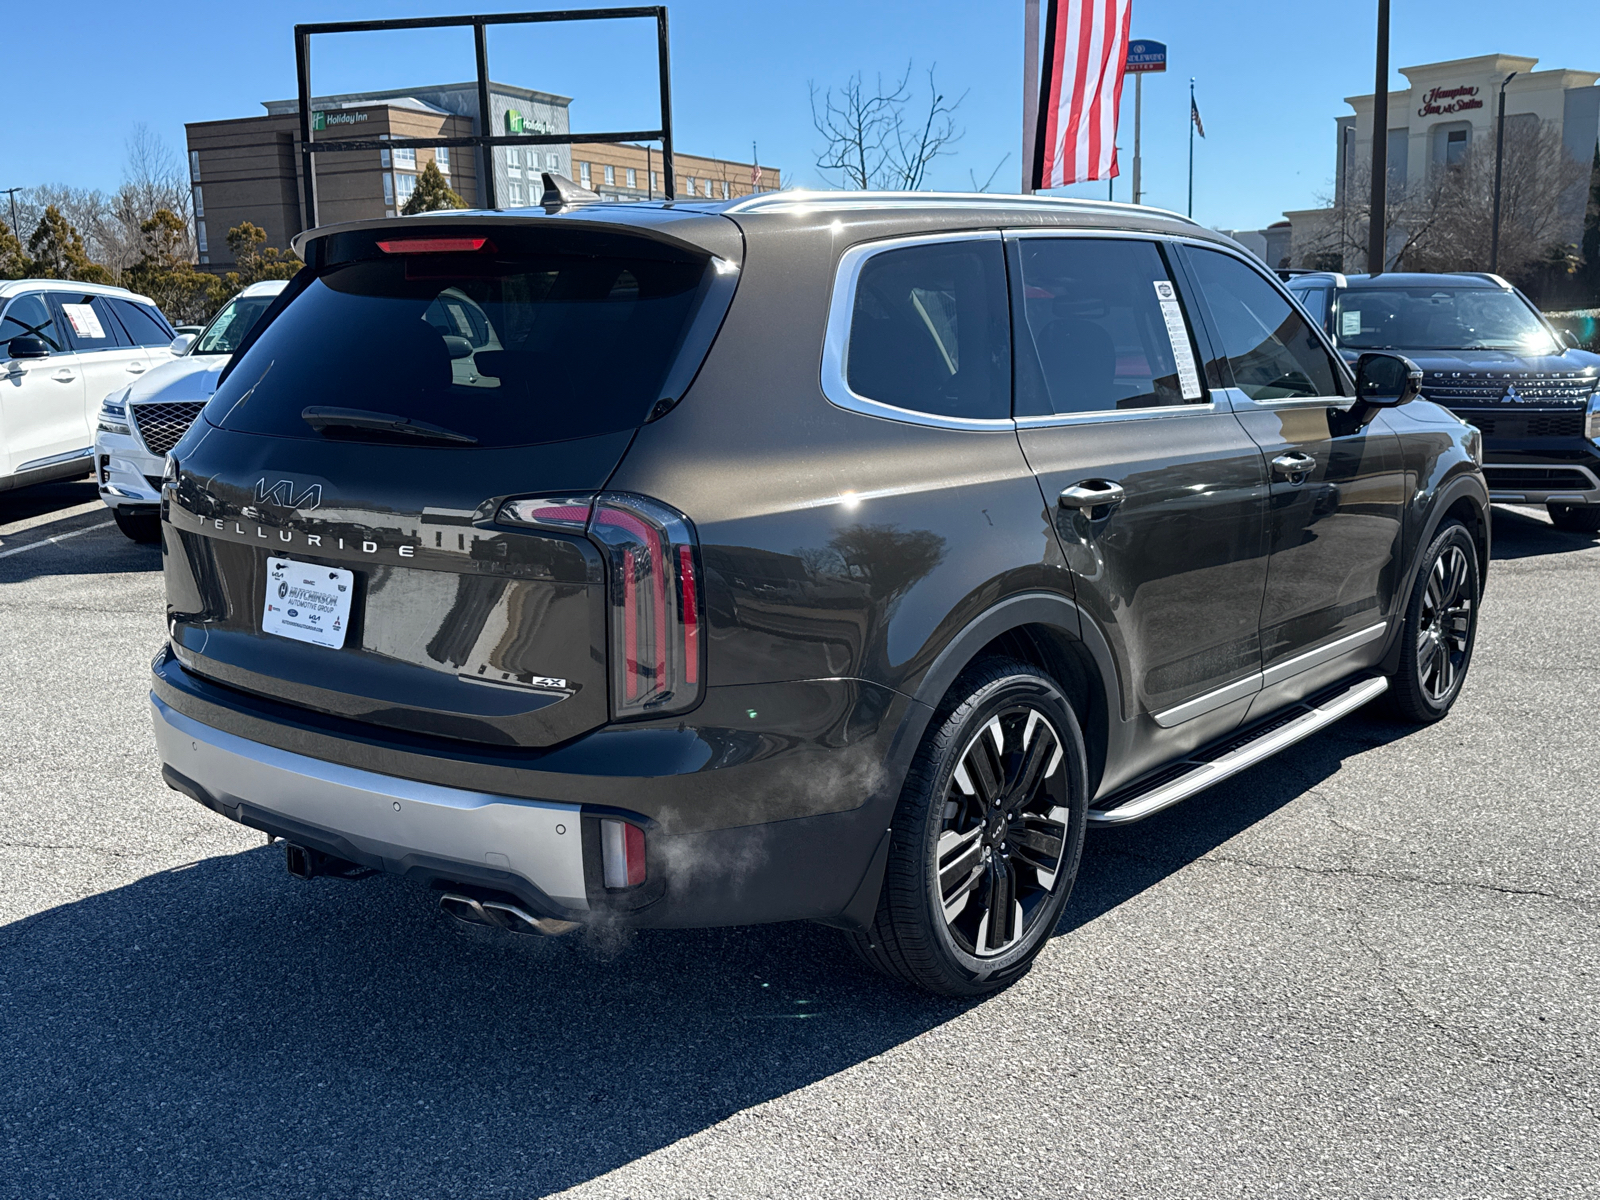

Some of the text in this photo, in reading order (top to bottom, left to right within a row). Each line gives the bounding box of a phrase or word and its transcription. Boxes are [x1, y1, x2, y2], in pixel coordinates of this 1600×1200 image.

[1127, 53, 1164, 62] NDLEWOOD
[1422, 85, 1479, 103] Hampton
[1418, 102, 1444, 117] Inn
[1452, 98, 1483, 112] Suites
[327, 113, 355, 125] Holiday
[356, 112, 368, 121] Inn
[523, 117, 546, 134] Holiday
[546, 121, 555, 133] Inn
[1433, 371, 1575, 379] OUTLANDER
[254, 476, 322, 511] KIA
[197, 514, 414, 558] TELLURIDE
[288, 586, 338, 606] HUTCHINSON
[287, 598, 317, 611] AUTOMOTIVE
[317, 604, 335, 614] GROUP
[1229, 719, 1289, 750] TELLURIDE
